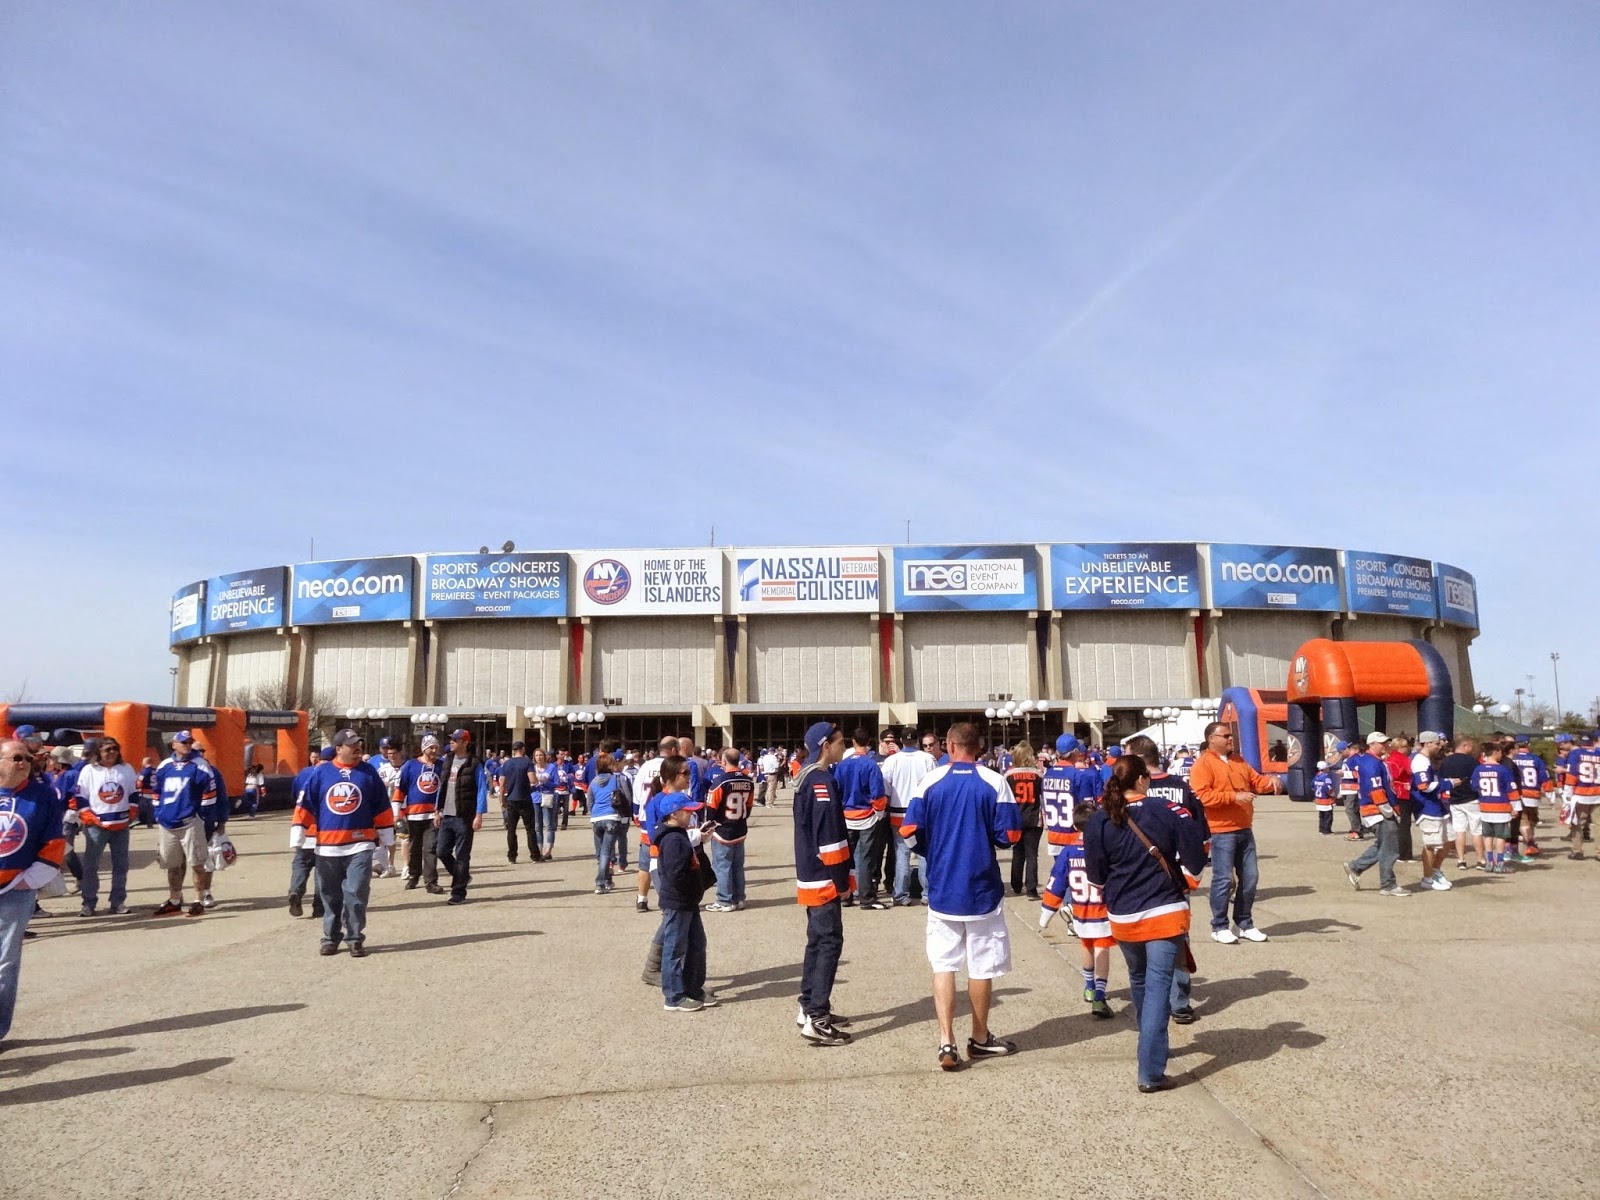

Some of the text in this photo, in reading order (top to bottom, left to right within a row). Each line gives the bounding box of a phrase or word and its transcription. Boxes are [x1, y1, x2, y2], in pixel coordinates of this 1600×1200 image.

[432, 561, 560, 576] SPORTS CONCERTS
[644, 558, 706, 571] HOME OF THE
[761, 557, 840, 580] NASSAU
[841, 562, 878, 573] VETERANS
[970, 563, 1018, 572] NATIONAL
[1081, 561, 1171, 574] UNBELIEVABLE
[1355, 559, 1430, 579] SPORTS CONCERTS
[644, 571, 708, 586] NEW YORK
[970, 572, 999, 581] EVENT
[1221, 561, 1334, 585] neco.com
[297, 574, 404, 599] neco.com
[431, 576, 560, 590] BROADWAY SHOWS
[797, 580, 879, 601] COLISEUM
[970, 582, 1019, 591] COMPANY
[1065, 575, 1189, 595] EXPERIENCE
[1356, 573, 1432, 593] BROADWAY SHOWS
[218, 585, 266, 602] UNBELIEVABLE
[431, 590, 560, 601] PREMIERES EVENT PACKAGES
[644, 586, 721, 603] ISLANDERS
[761, 586, 796, 596] MEMORIAL
[1357, 587, 1388, 597] PREMIERES
[1392, 589, 1409, 599] EVENT
[211, 597, 275, 621] EXPERIENCE
[1370, 776, 1383, 788] 17
[1419, 771, 1428, 782] 2
[1043, 778, 1071, 791] CIZIKAS
[1479, 777, 1501, 797] 91
[1015, 781, 1036, 804] 91
[725, 791, 750, 821] 91
[1043, 791, 1074, 828] 53
[1068, 858, 1087, 868] TAVA
[1068, 870, 1102, 903] 91
